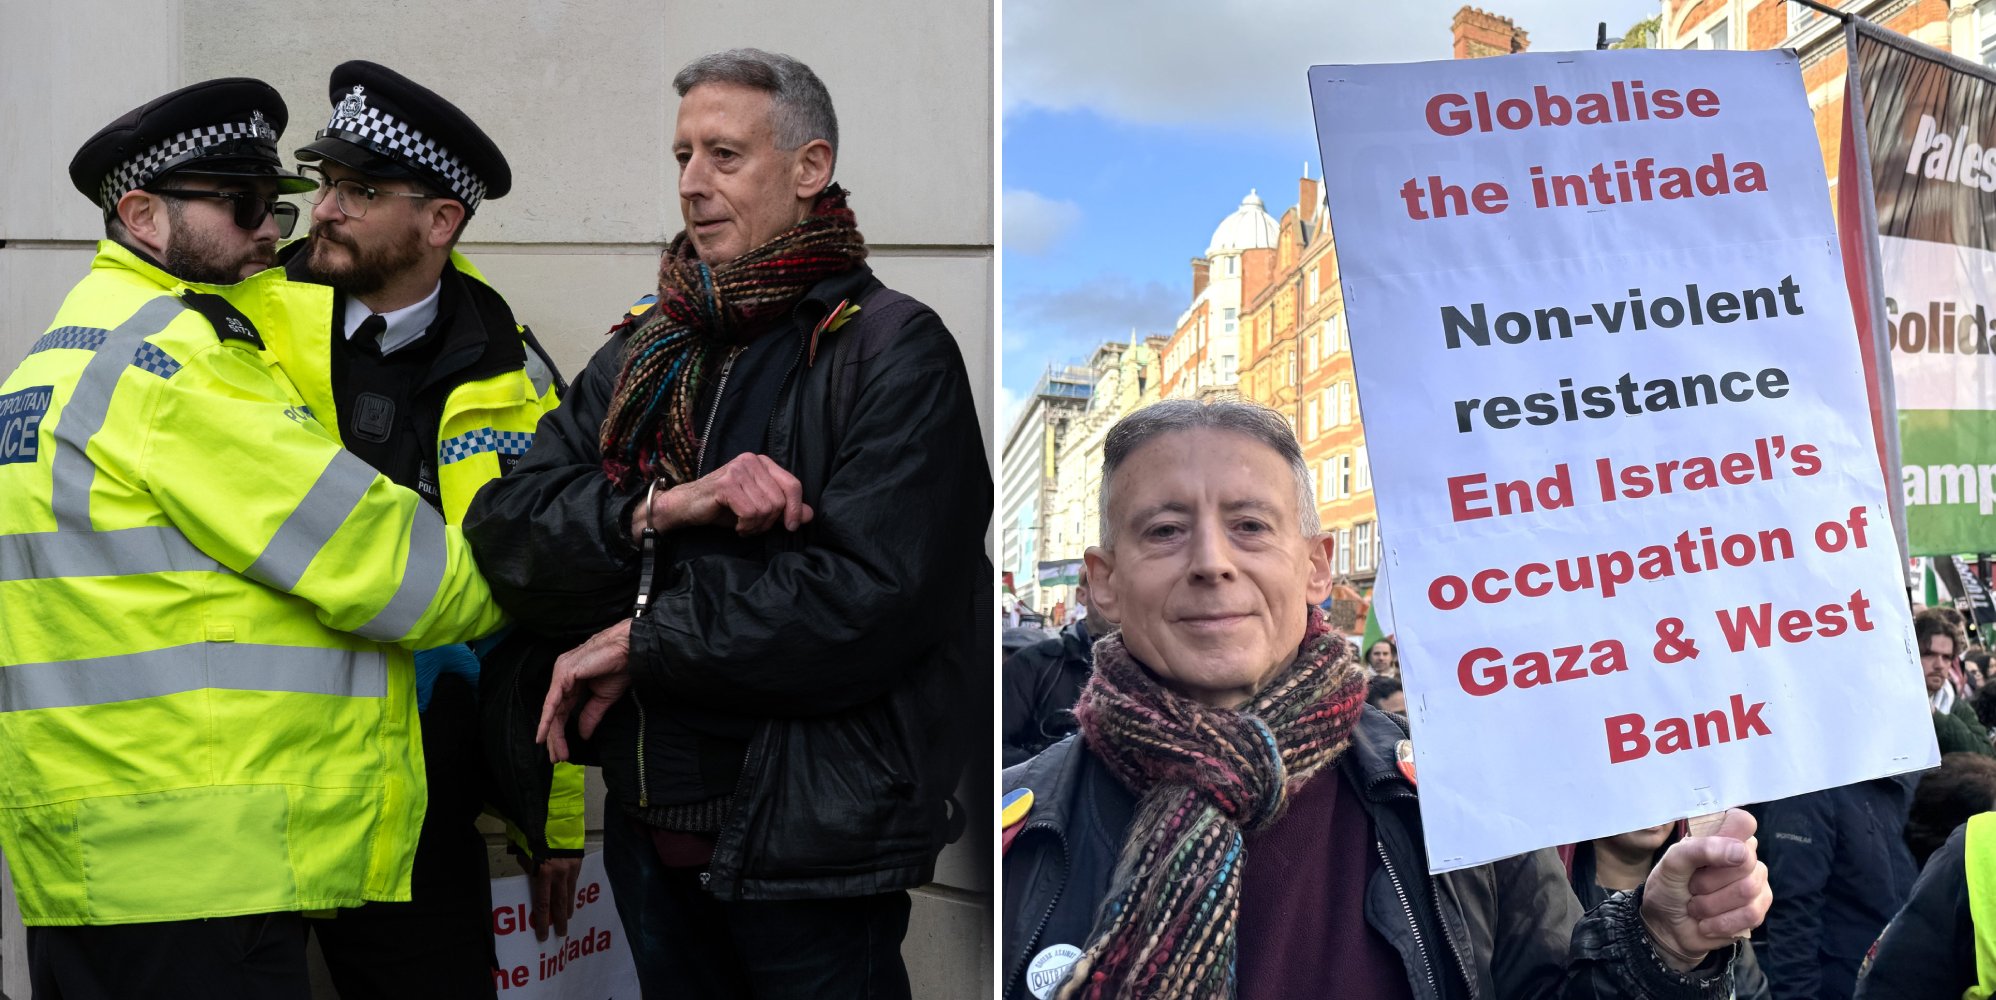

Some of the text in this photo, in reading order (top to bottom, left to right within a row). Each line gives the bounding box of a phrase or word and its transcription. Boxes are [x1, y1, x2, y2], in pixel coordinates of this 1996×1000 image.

[1425, 81, 1721, 136] Globalise
[1400, 153, 1769, 220] the intifada
[1440, 275, 1804, 349] Non-violent
[1454, 367, 1790, 433] resistance
[0, 415, 41, 459] ICE
[1447, 463, 1574, 522] End
[1428, 506, 1868, 611] occupation of
[1457, 589, 1874, 697] Gaza & West
[1605, 693, 1772, 765] Bank
